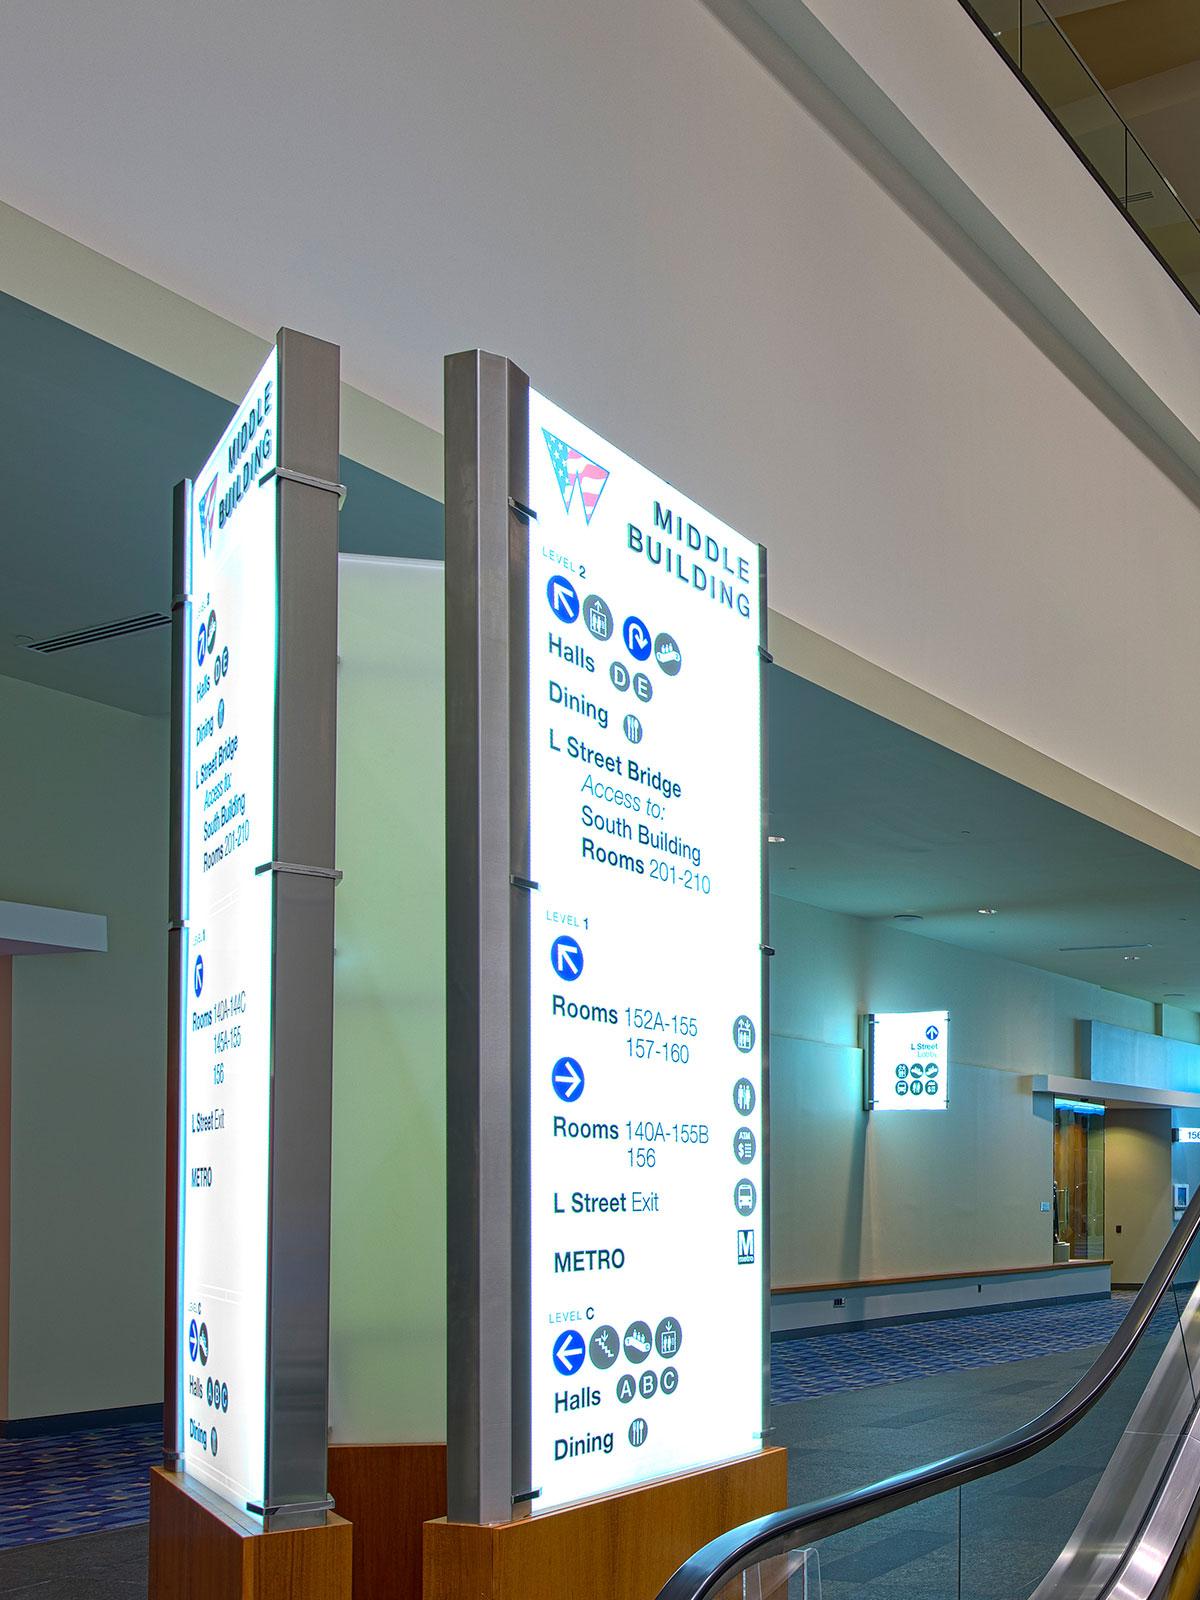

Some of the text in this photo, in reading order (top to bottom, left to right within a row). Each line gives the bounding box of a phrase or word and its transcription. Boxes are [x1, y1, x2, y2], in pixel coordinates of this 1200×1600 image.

[228, 380, 273, 473] MIDDLE
[218, 428, 272, 529] BUILDING
[653, 501, 751, 584] MIDDLE
[542, 546, 586, 579] LEVEL 2
[627, 523, 751, 619] BUILDING
[548, 632, 595, 673] Halls
[549, 680, 608, 729] Dining
[196, 716, 214, 747] Dining
[200, 752, 218, 785] Street
[219, 735, 238, 768] Bridge
[549, 728, 682, 798] L Street Bridge
[204, 780, 224, 811] Access
[581, 774, 666, 820] Access to:
[204, 793, 245, 842] South Building
[203, 819, 249, 873] Rooms 201-210
[582, 805, 701, 866] South Building
[582, 837, 711, 894] Rooms 201-210
[546, 910, 589, 930] LEVEL 1
[192, 1010, 212, 1032] Rooms
[552, 994, 698, 1037] Rooms 152A-155
[627, 1037, 689, 1064] 157-160
[917, 1042, 938, 1050] Street
[196, 1110, 214, 1133] Street
[214, 1108, 225, 1130] Exit
[553, 1115, 710, 1144] Rooms 140A-155B
[627, 1147, 656, 1168] 156
[191, 1166, 212, 1188] METRO
[554, 1191, 659, 1213] L Street Exit
[554, 1248, 625, 1273] METRO
[549, 1306, 595, 1324] LEVEL C
[189, 1373, 203, 1400] Halls
[554, 1370, 676, 1413] Halls A B C
[189, 1417, 208, 1451] Dining
[554, 1432, 614, 1461] Dining
